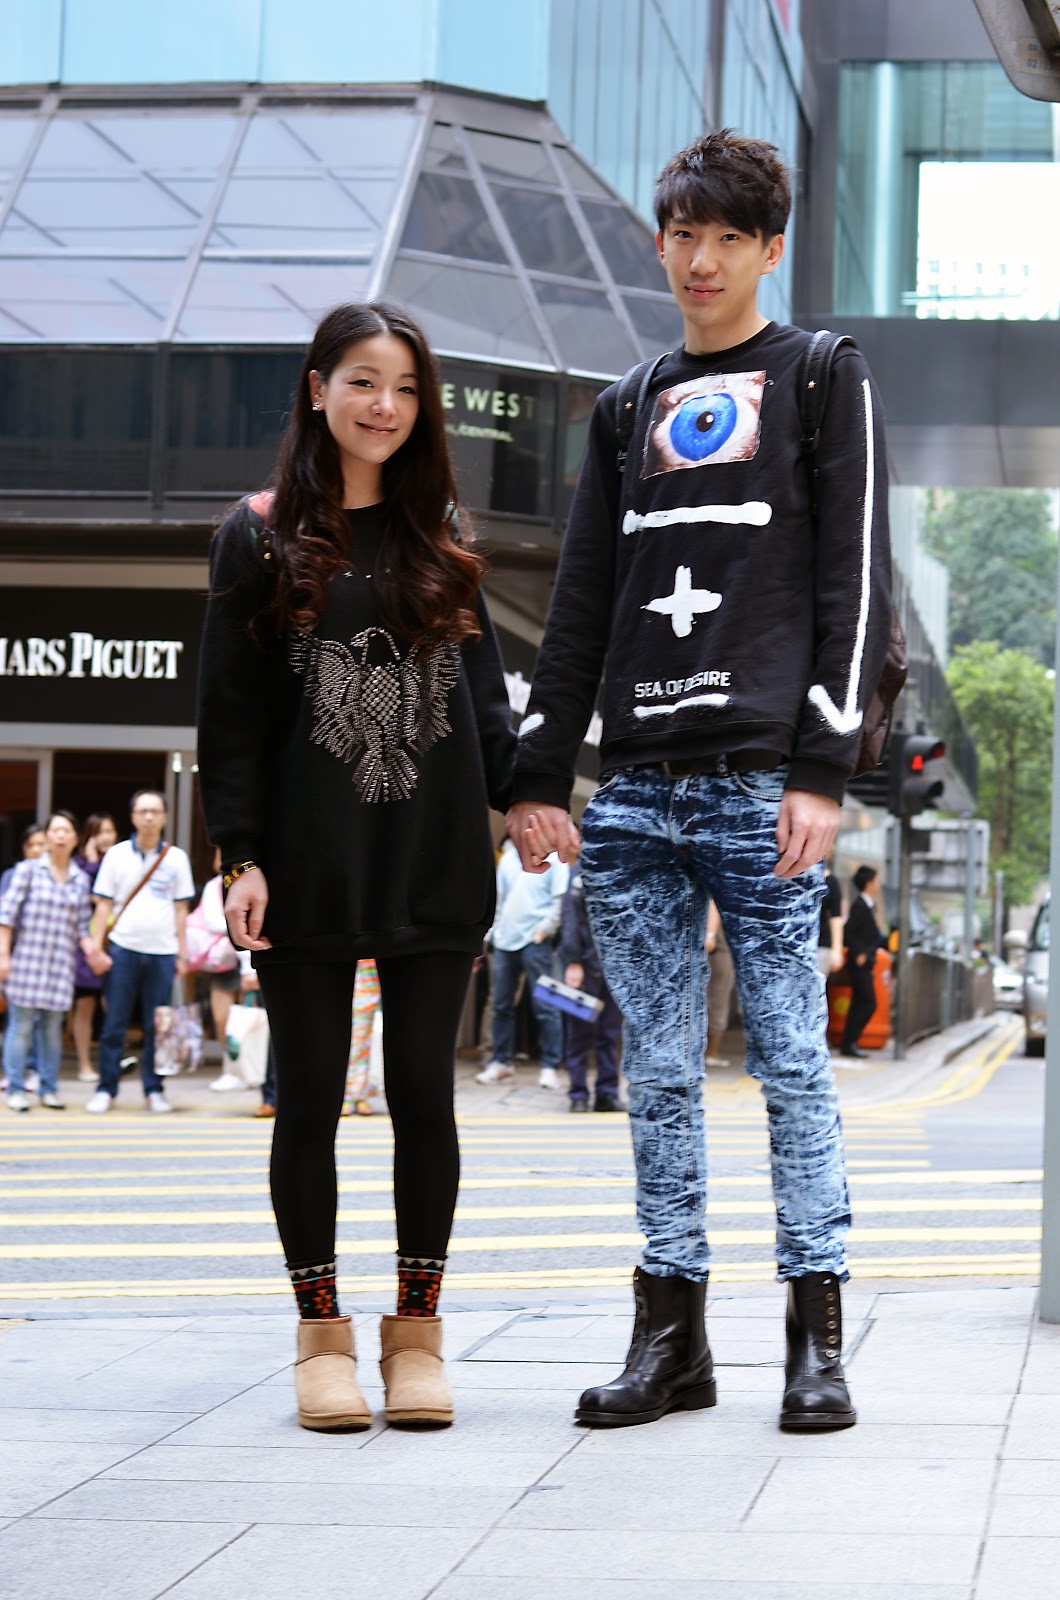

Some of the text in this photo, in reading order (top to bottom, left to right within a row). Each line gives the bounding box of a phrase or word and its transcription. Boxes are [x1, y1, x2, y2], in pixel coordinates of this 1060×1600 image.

[463, 386, 537, 419] WEST
[67, 631, 184, 679] PIGUET
[634, 681, 663, 698] SEA
[665, 679, 685, 695] OF
